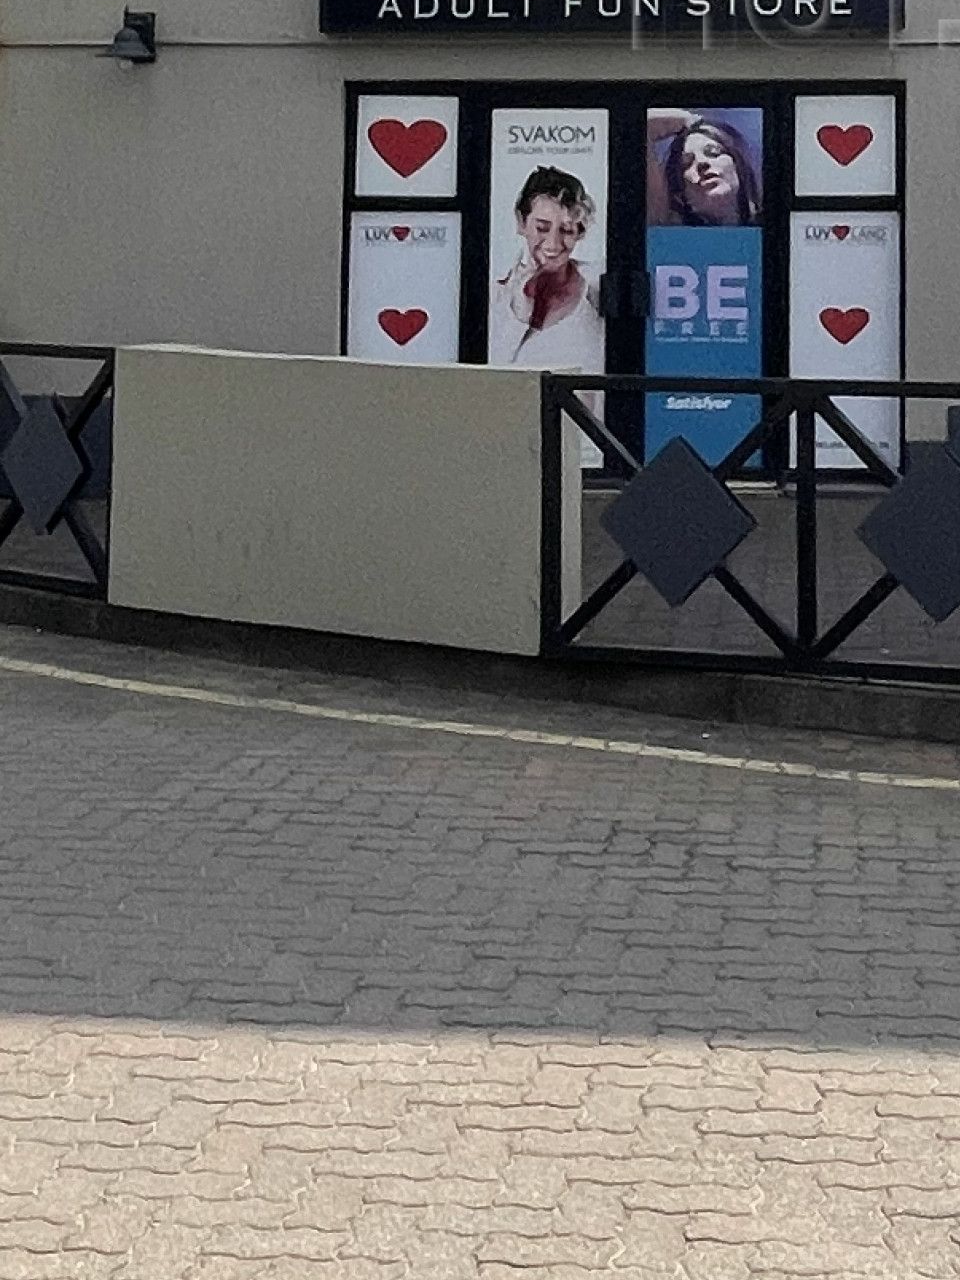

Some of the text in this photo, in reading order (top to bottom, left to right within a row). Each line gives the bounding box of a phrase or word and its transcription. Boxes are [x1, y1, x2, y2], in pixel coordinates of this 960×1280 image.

[508, 124, 596, 144] SVAKOM
[365, 225, 391, 240] LUV
[805, 225, 831, 240] LUV
[654, 265, 749, 321] BE
[654, 320, 749, 336] FREE
